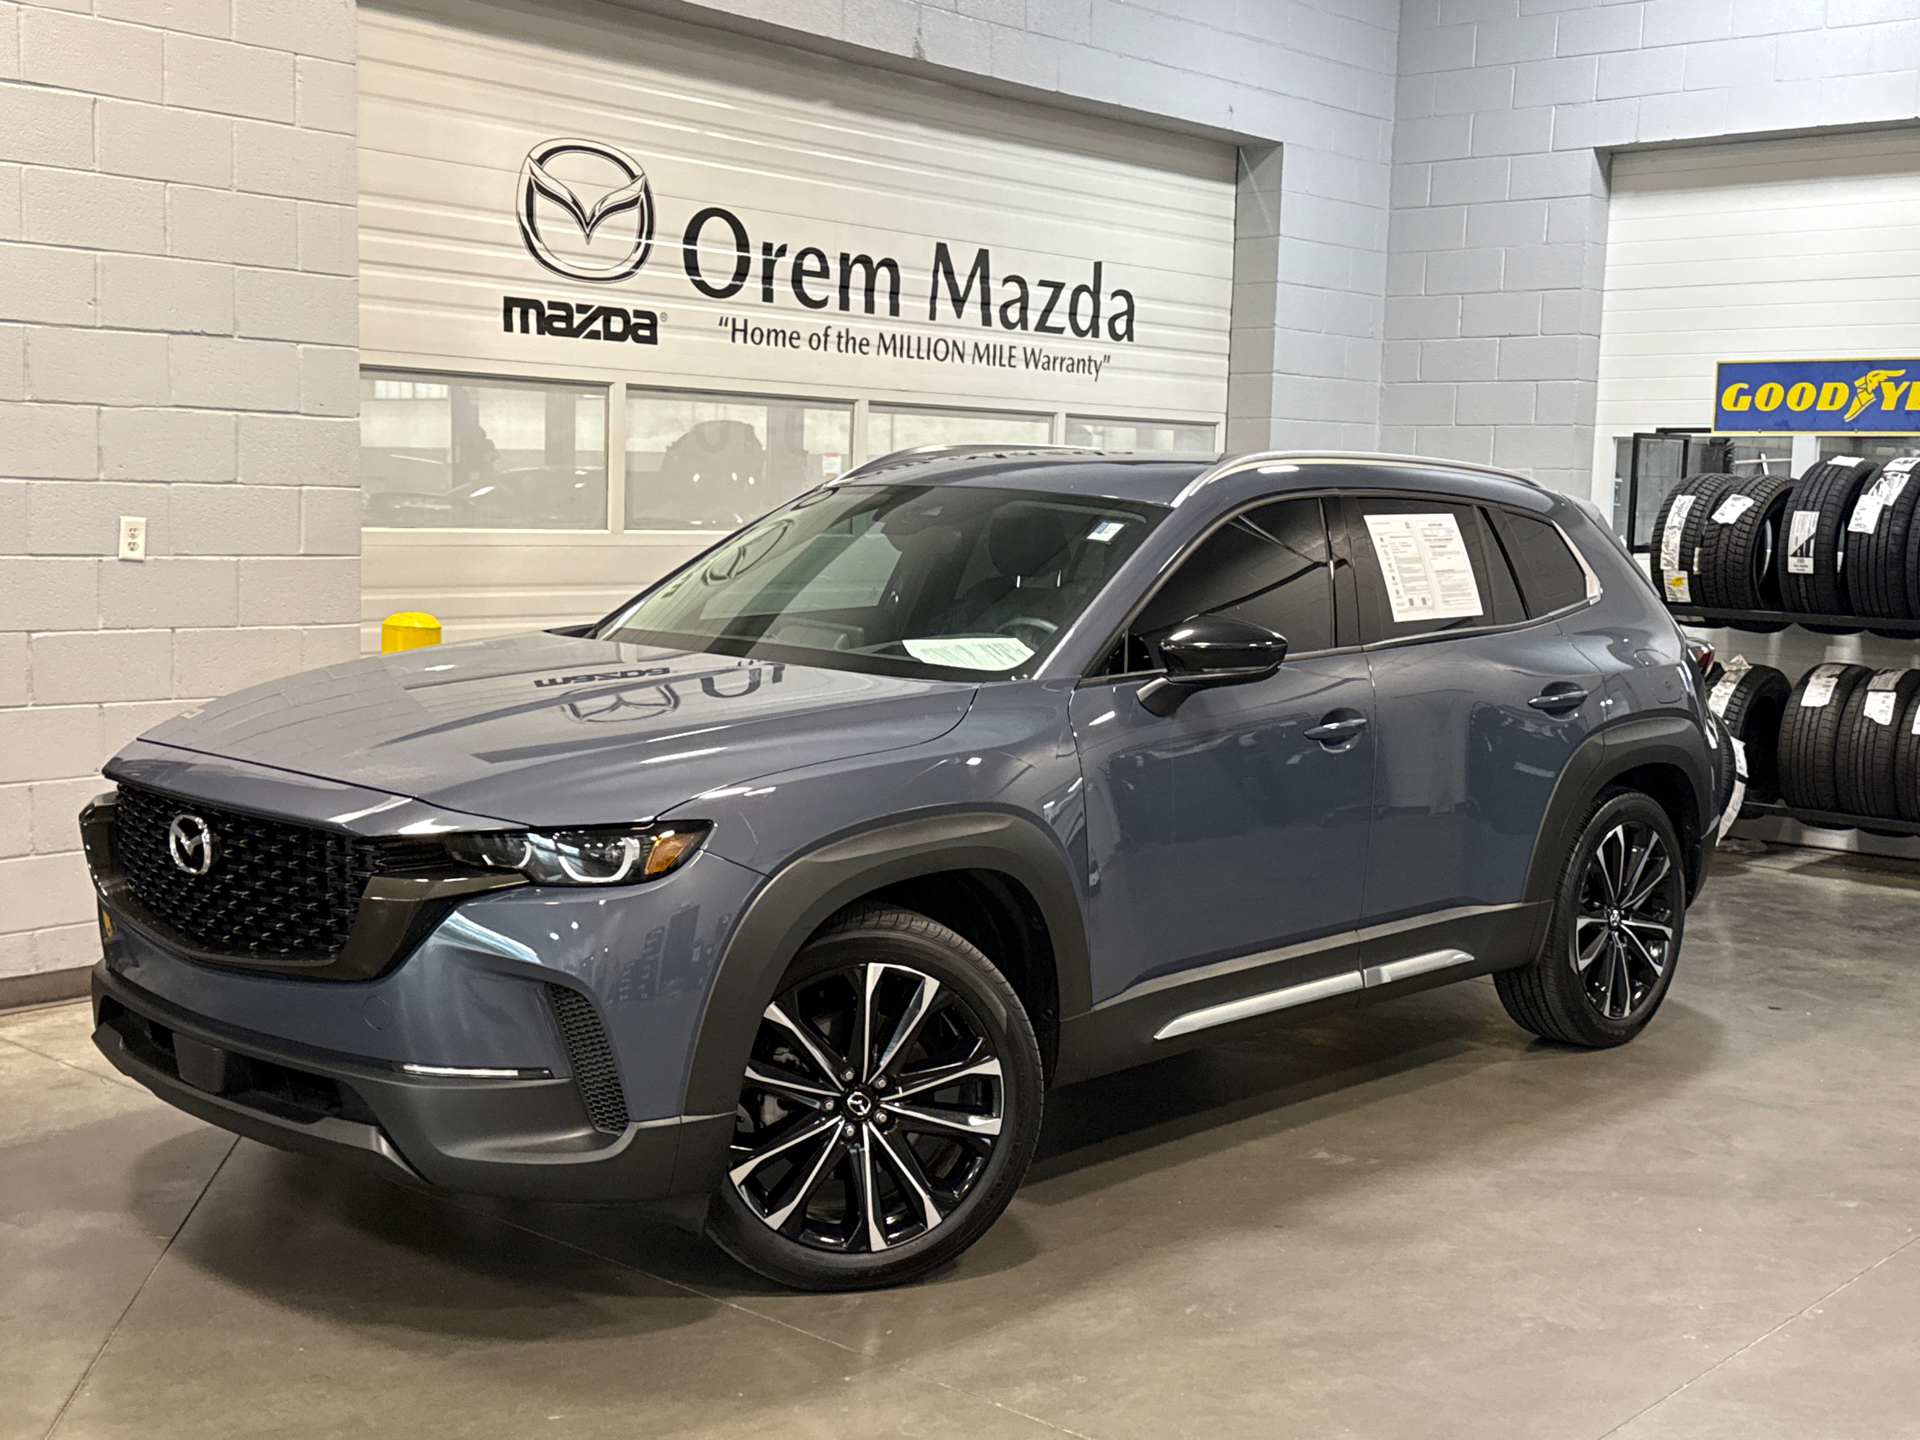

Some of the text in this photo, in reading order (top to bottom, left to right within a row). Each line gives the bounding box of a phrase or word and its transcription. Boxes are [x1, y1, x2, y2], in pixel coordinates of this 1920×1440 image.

[682, 207, 1135, 343] Orem Mazda
[503, 296, 658, 346] mazda
[808, 326, 832, 352] of
[836, 328, 870, 356] the
[876, 332, 966, 364] MILLION
[971, 342, 1017, 369] MILE
